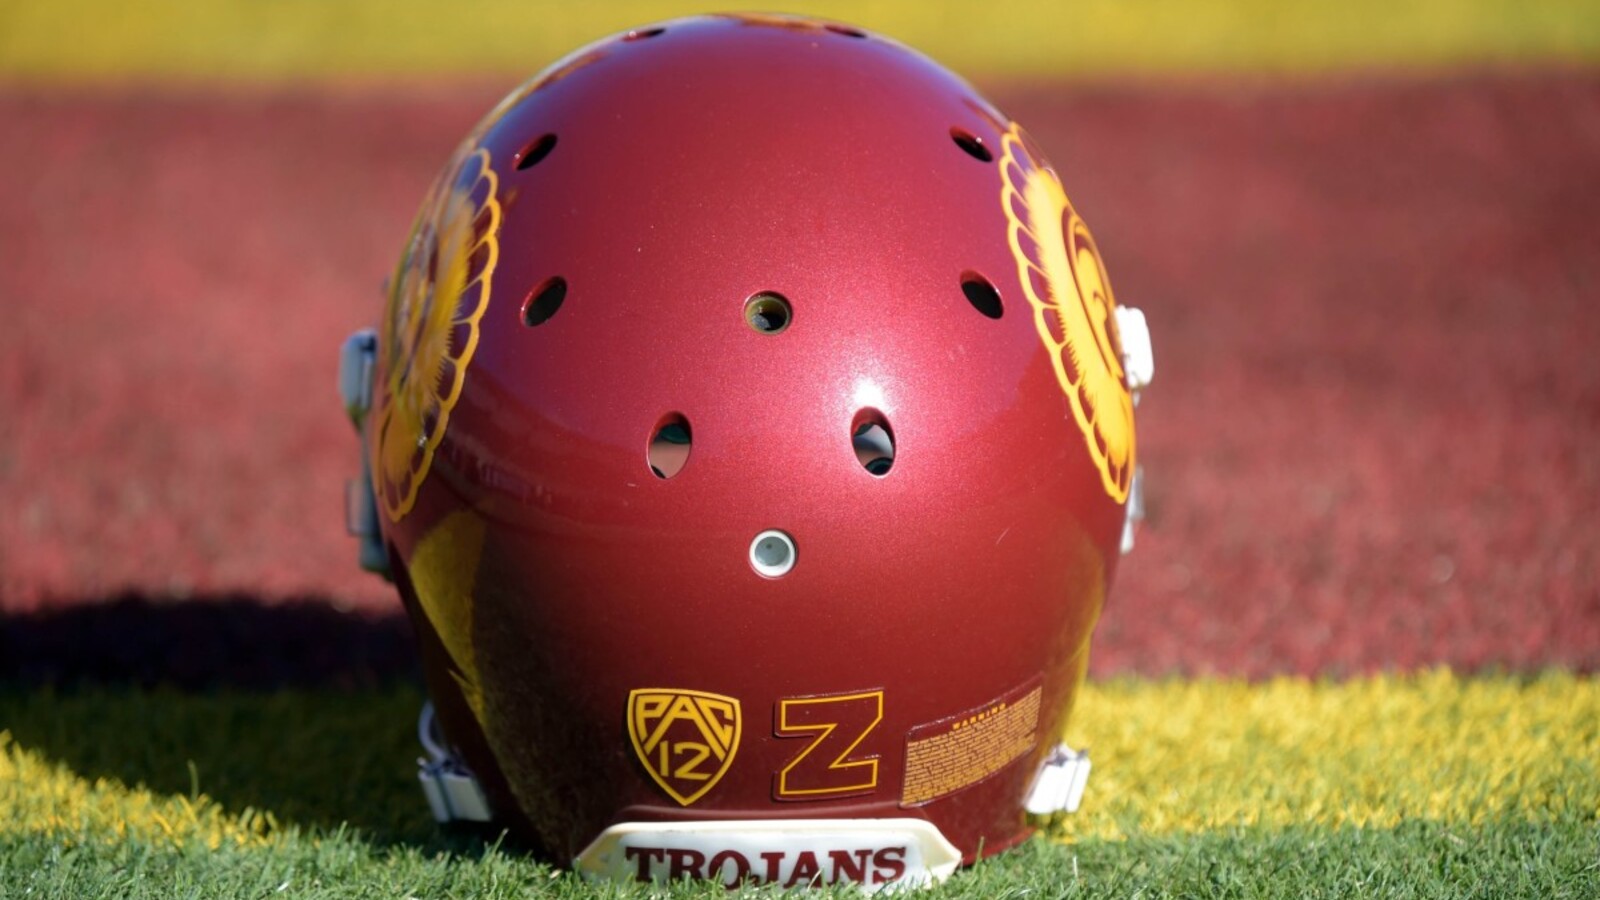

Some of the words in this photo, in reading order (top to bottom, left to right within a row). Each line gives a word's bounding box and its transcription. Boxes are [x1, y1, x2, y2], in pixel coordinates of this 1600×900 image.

[636, 695, 734, 762] PAC
[780, 690, 884, 796] Z
[660, 740, 712, 780] 12
[626, 846, 907, 891] TROJANS
